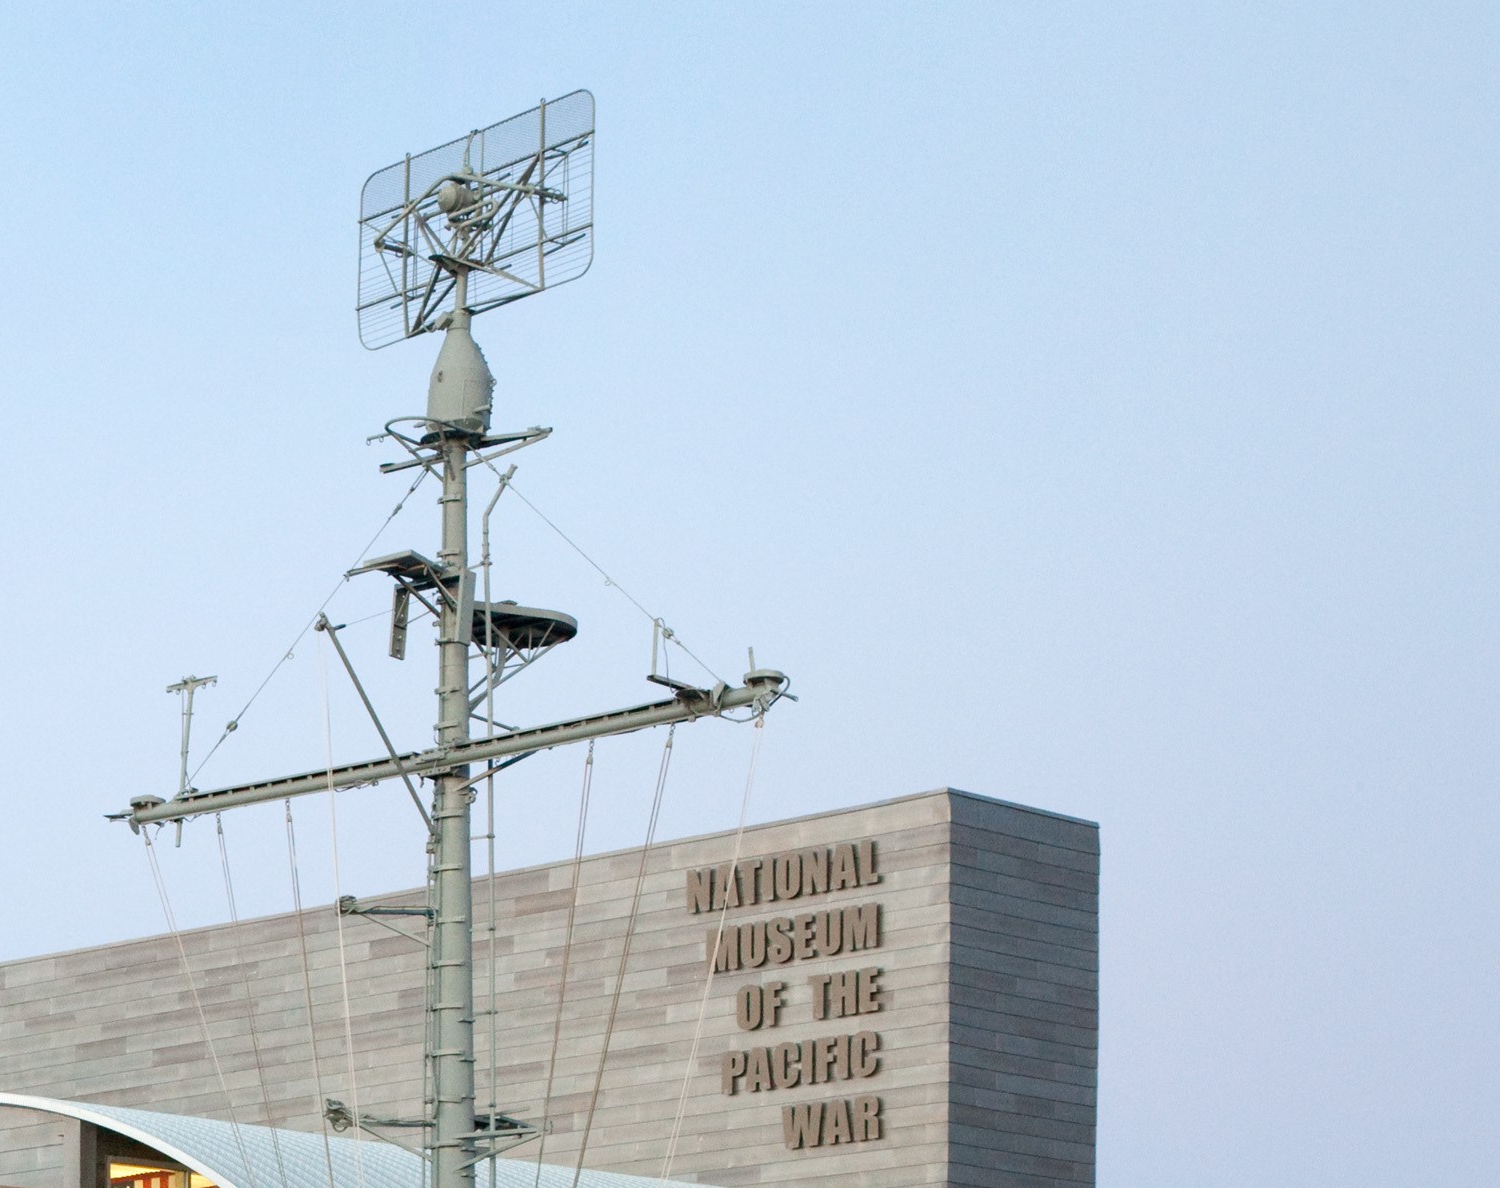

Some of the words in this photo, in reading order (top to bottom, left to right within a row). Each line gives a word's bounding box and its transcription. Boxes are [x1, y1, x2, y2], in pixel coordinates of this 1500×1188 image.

[686, 839, 881, 914] NATIONAL
[706, 902, 882, 974] MUSEUM
[736, 981, 786, 1031] OF
[808, 966, 882, 1021] THE
[721, 1030, 881, 1096] PACIFIC
[782, 1095, 883, 1150] WAR
